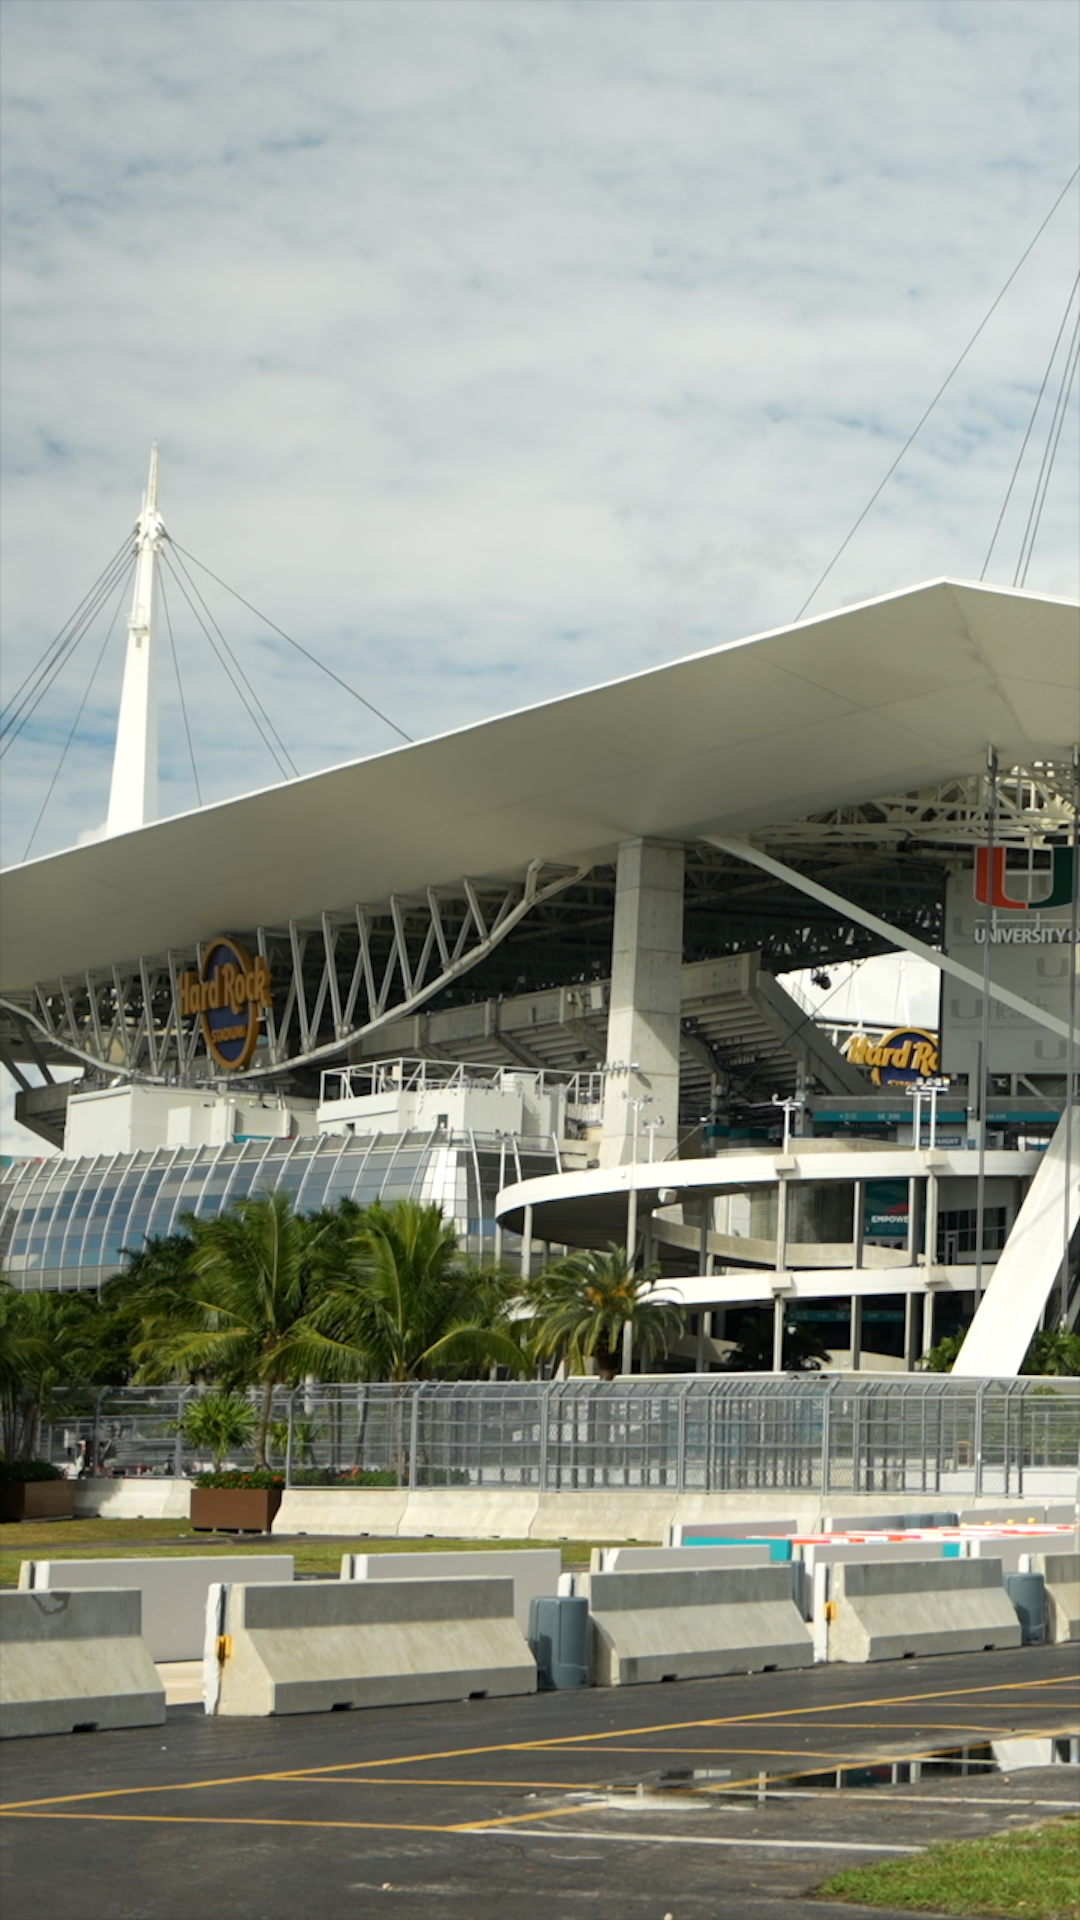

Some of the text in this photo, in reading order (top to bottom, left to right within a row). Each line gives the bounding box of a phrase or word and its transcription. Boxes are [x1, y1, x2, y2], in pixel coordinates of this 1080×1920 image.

[974, 928, 1080, 944] UNIVERSITY O
[178, 956, 273, 1015] Hard Rock
[847, 1037, 938, 1077] Hard Ro
[871, 1215, 909, 1223] EMPOWE
